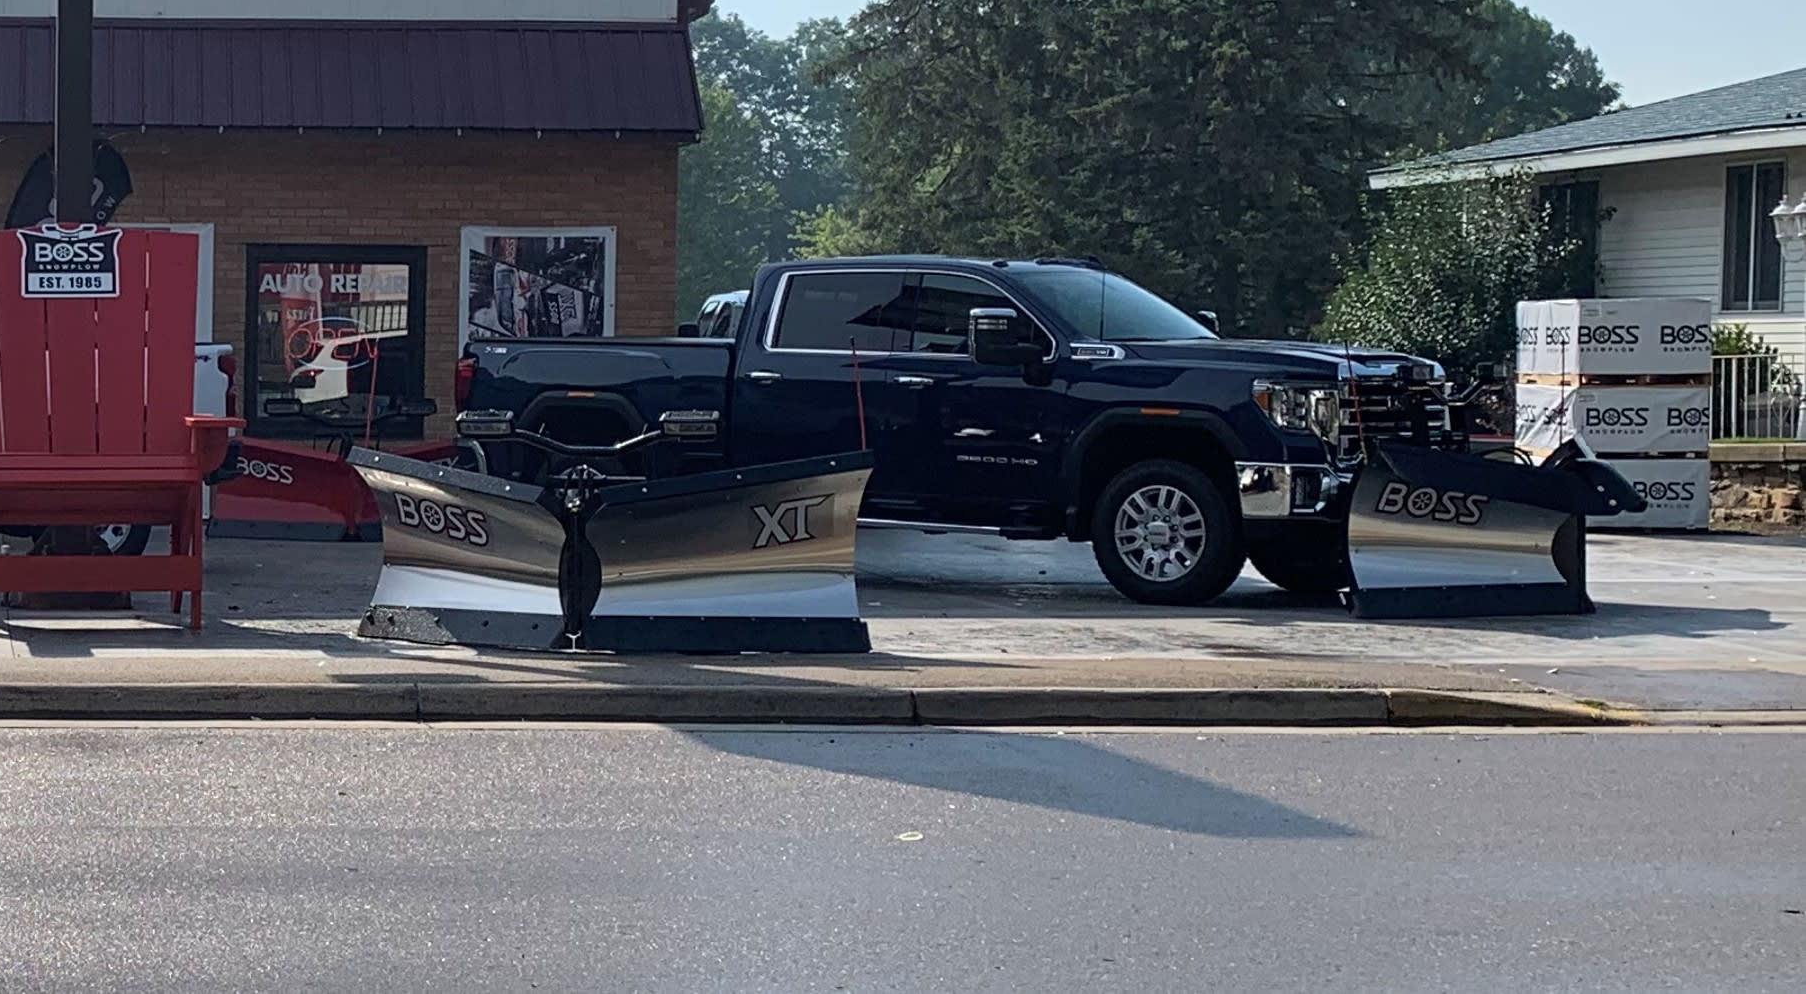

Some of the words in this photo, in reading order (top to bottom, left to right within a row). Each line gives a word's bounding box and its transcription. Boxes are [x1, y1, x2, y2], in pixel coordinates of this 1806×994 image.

[35, 243, 105, 262] BOSS
[39, 276, 64, 289] EST.
[69, 276, 102, 289] 1985
[259, 273, 323, 293] AUTO
[330, 273, 408, 294] REPAIR
[288, 327, 379, 359] OPEN
[1546, 326, 1570, 345] BOSS
[1578, 325, 1640, 344] BOSS
[1660, 324, 1710, 344] BOS
[1586, 407, 1650, 426] BOSS
[238, 457, 294, 485] BOSS
[1634, 481, 1696, 501] BOSS
[1377, 482, 1489, 524] BOSS
[394, 492, 488, 546] BOSS
[752, 495, 831, 548] XT
